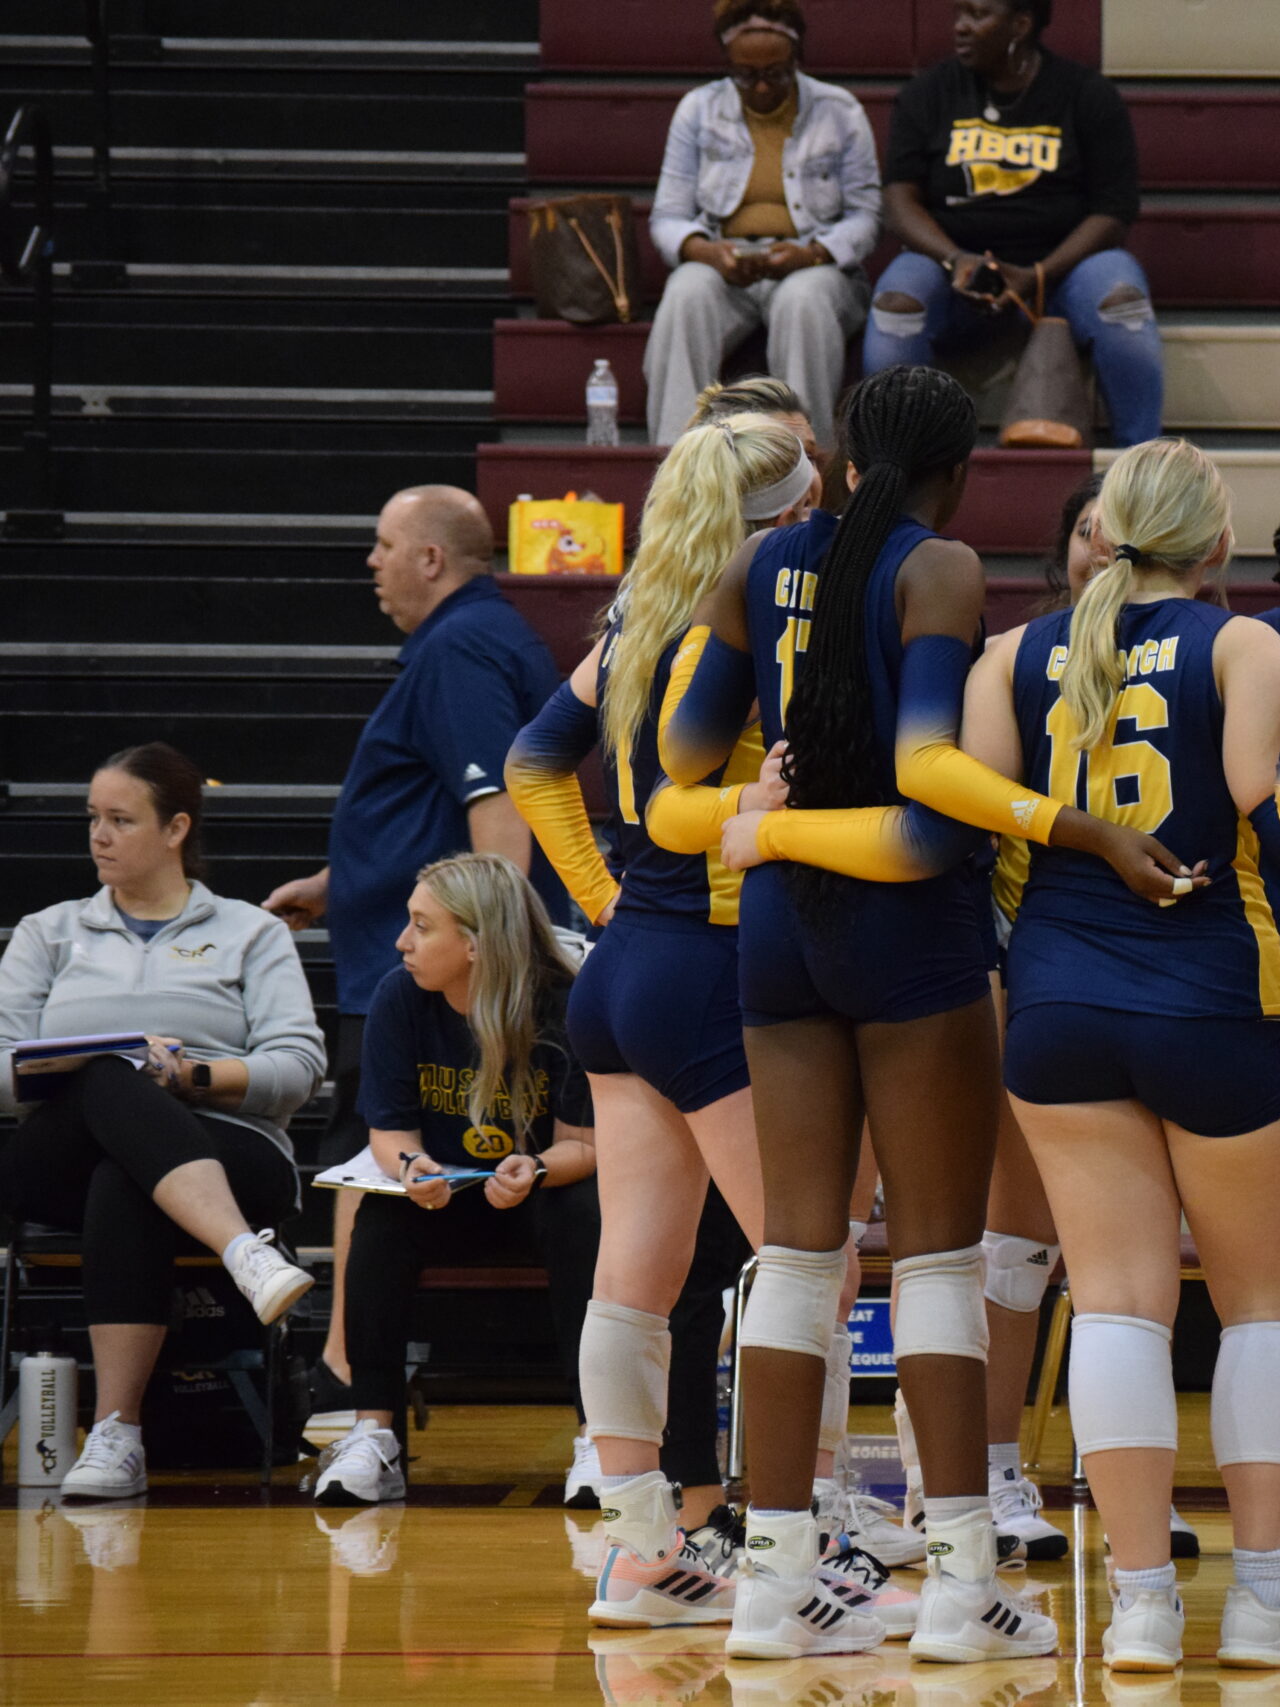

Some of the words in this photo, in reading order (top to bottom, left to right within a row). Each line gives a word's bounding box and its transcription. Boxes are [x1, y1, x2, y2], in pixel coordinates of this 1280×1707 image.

[945, 127, 1062, 172] HBCU
[1046, 682, 1174, 835] 16
[472, 1133, 505, 1153] 20
[41, 1369, 56, 1439] VOLLEYBALL
